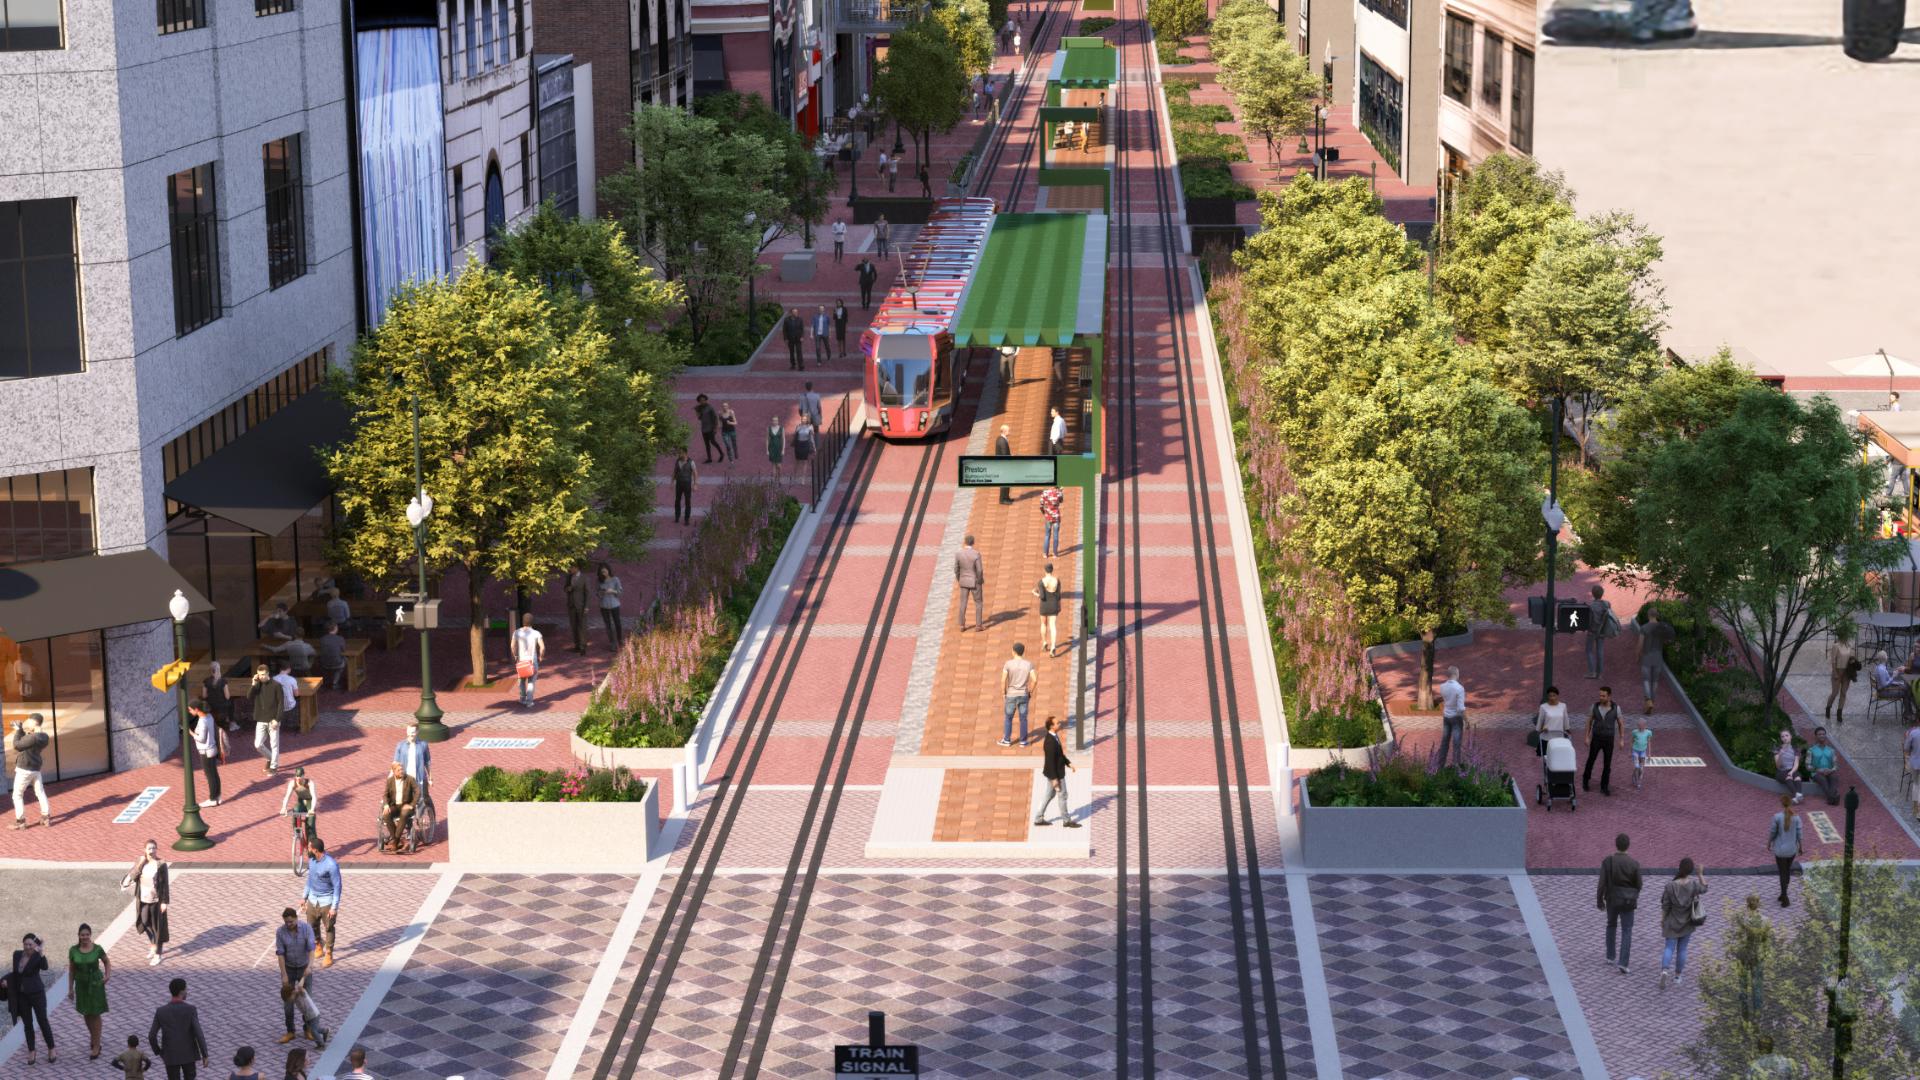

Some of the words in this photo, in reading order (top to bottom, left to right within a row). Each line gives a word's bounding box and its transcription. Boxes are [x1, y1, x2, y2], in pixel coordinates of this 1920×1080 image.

[964, 465, 988, 473] Preston
[848, 1047, 905, 1058] TRAIN
[841, 1061, 912, 1073] SIGNAL
